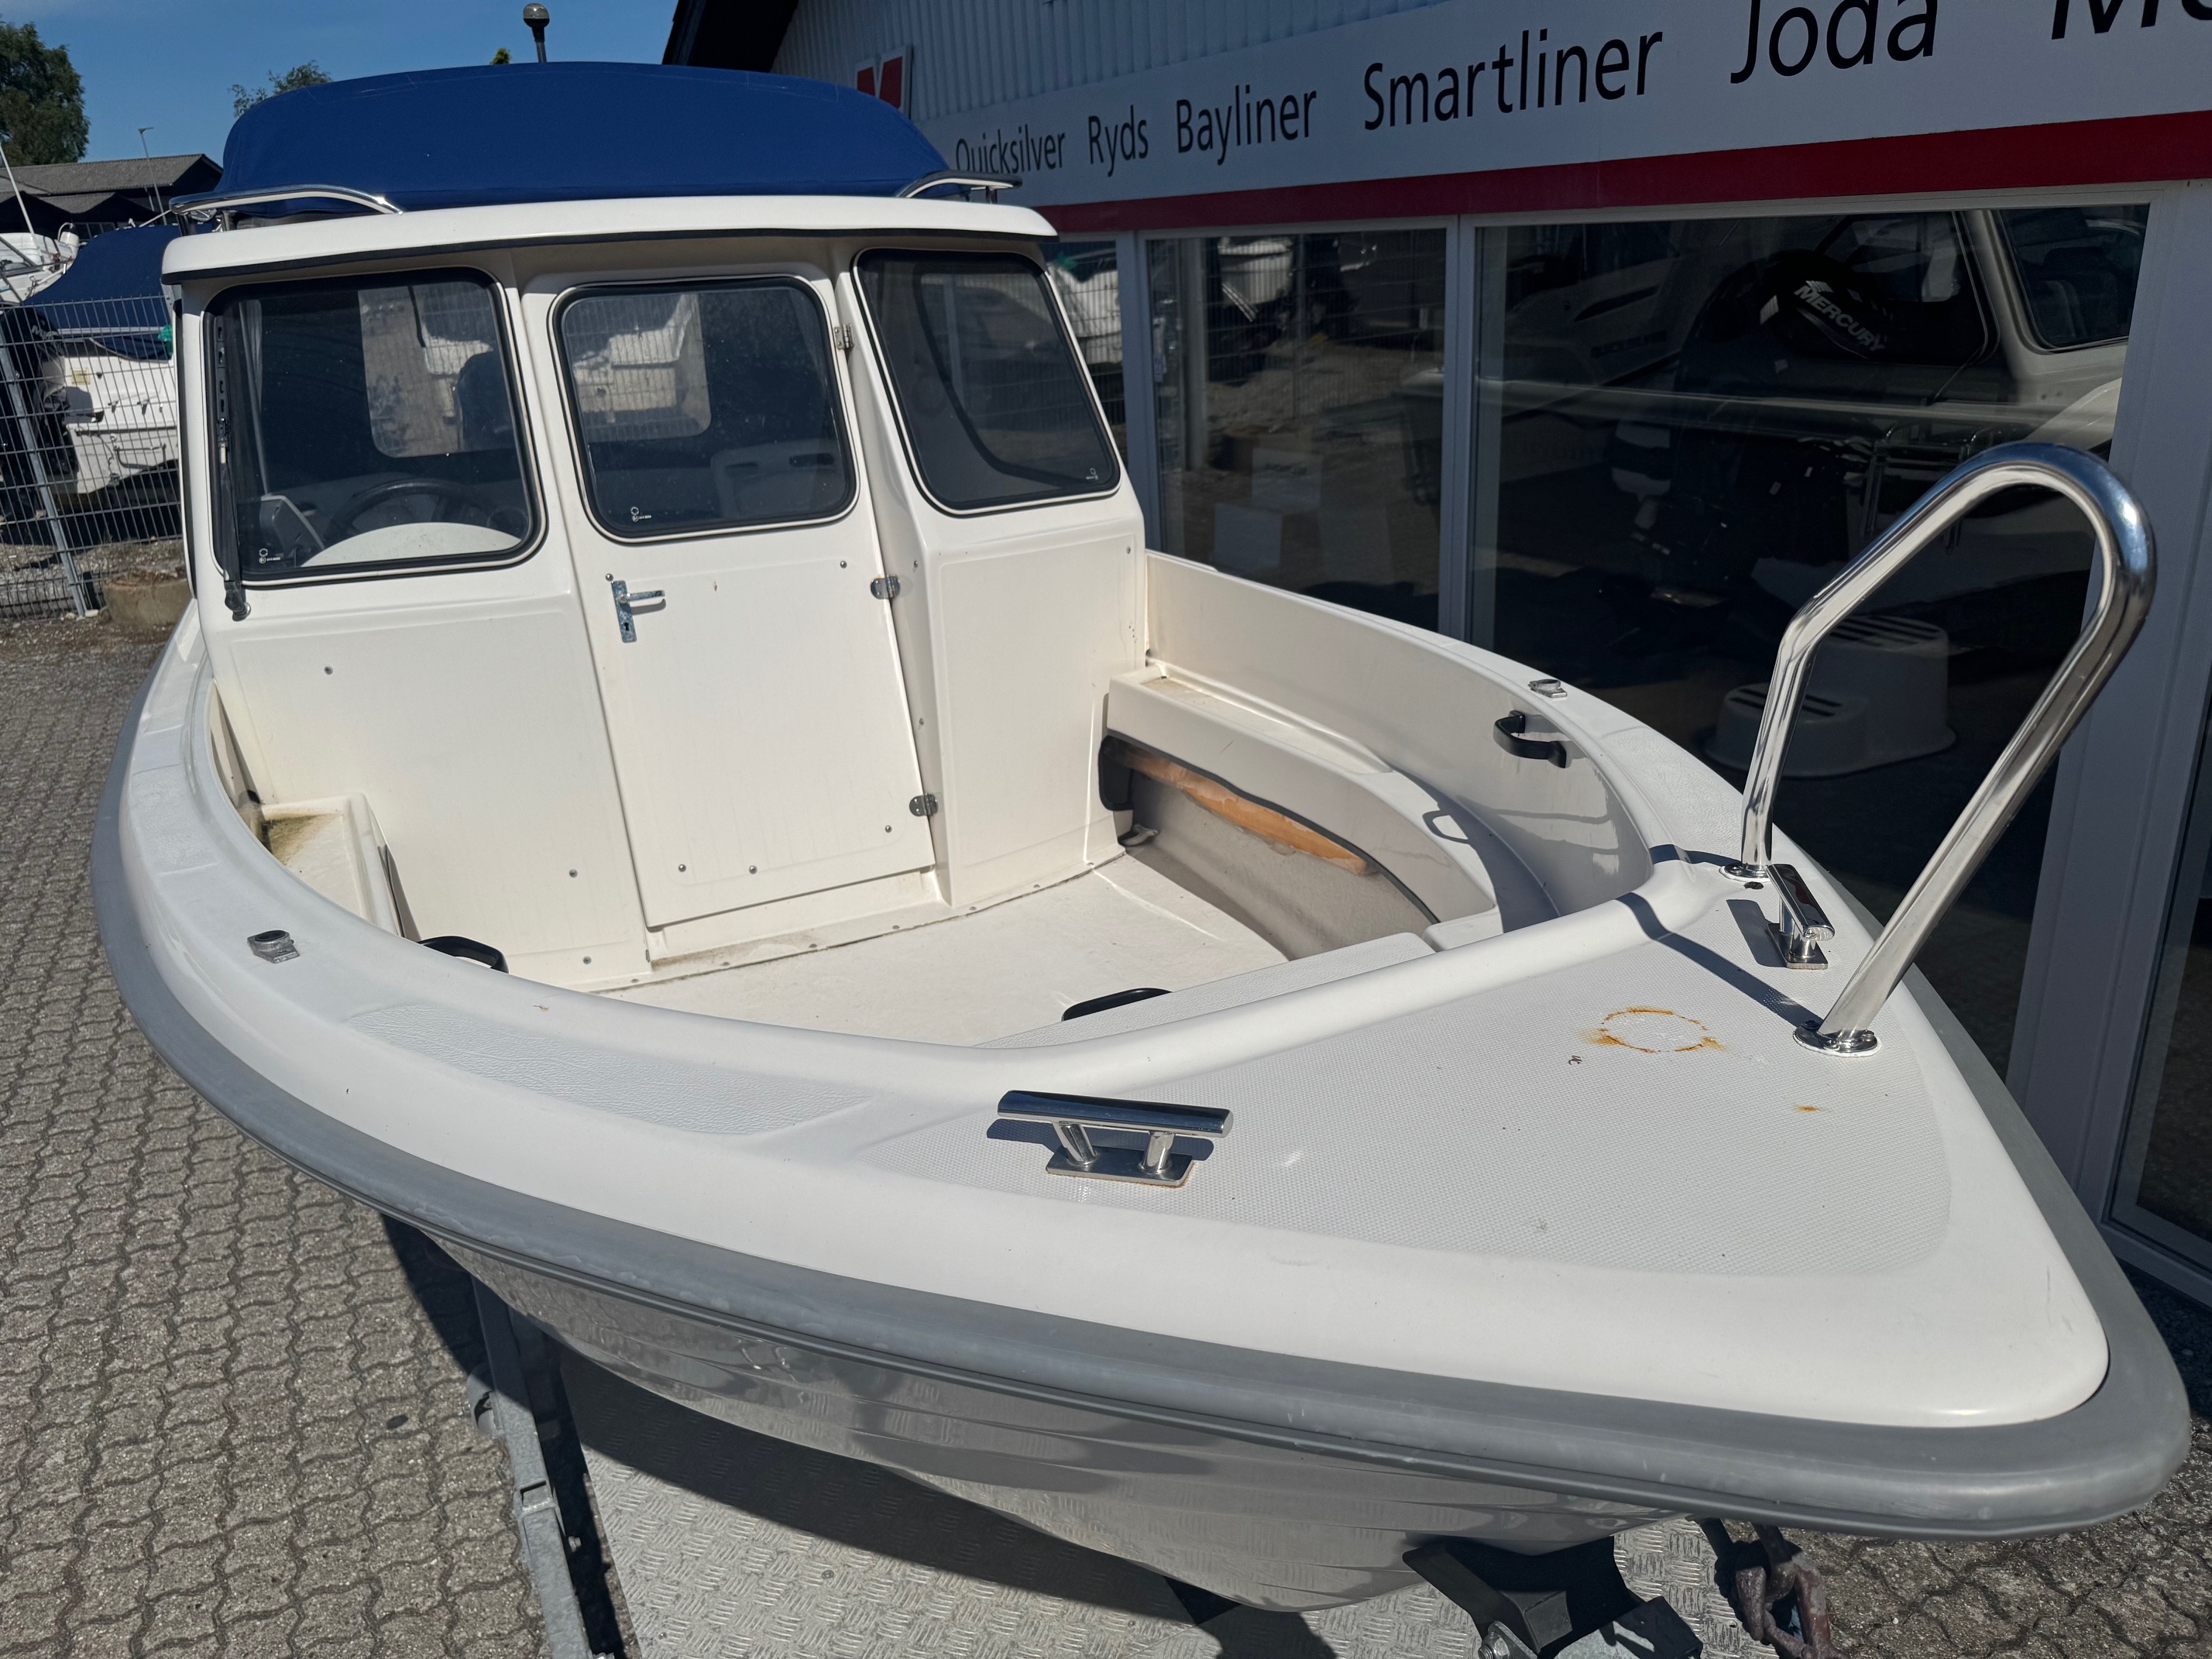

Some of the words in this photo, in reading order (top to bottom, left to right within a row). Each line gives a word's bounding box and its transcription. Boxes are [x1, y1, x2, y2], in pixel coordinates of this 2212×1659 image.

[956, 124, 1066, 173] Quicksilver
[1088, 105, 1149, 177] Ryds
[1176, 84, 1317, 165] Bayliner
[1364, 29, 1664, 130] Smartliner
[1730, 0, 1938, 84] Joda
[1793, 284, 1886, 351] MERCURY
